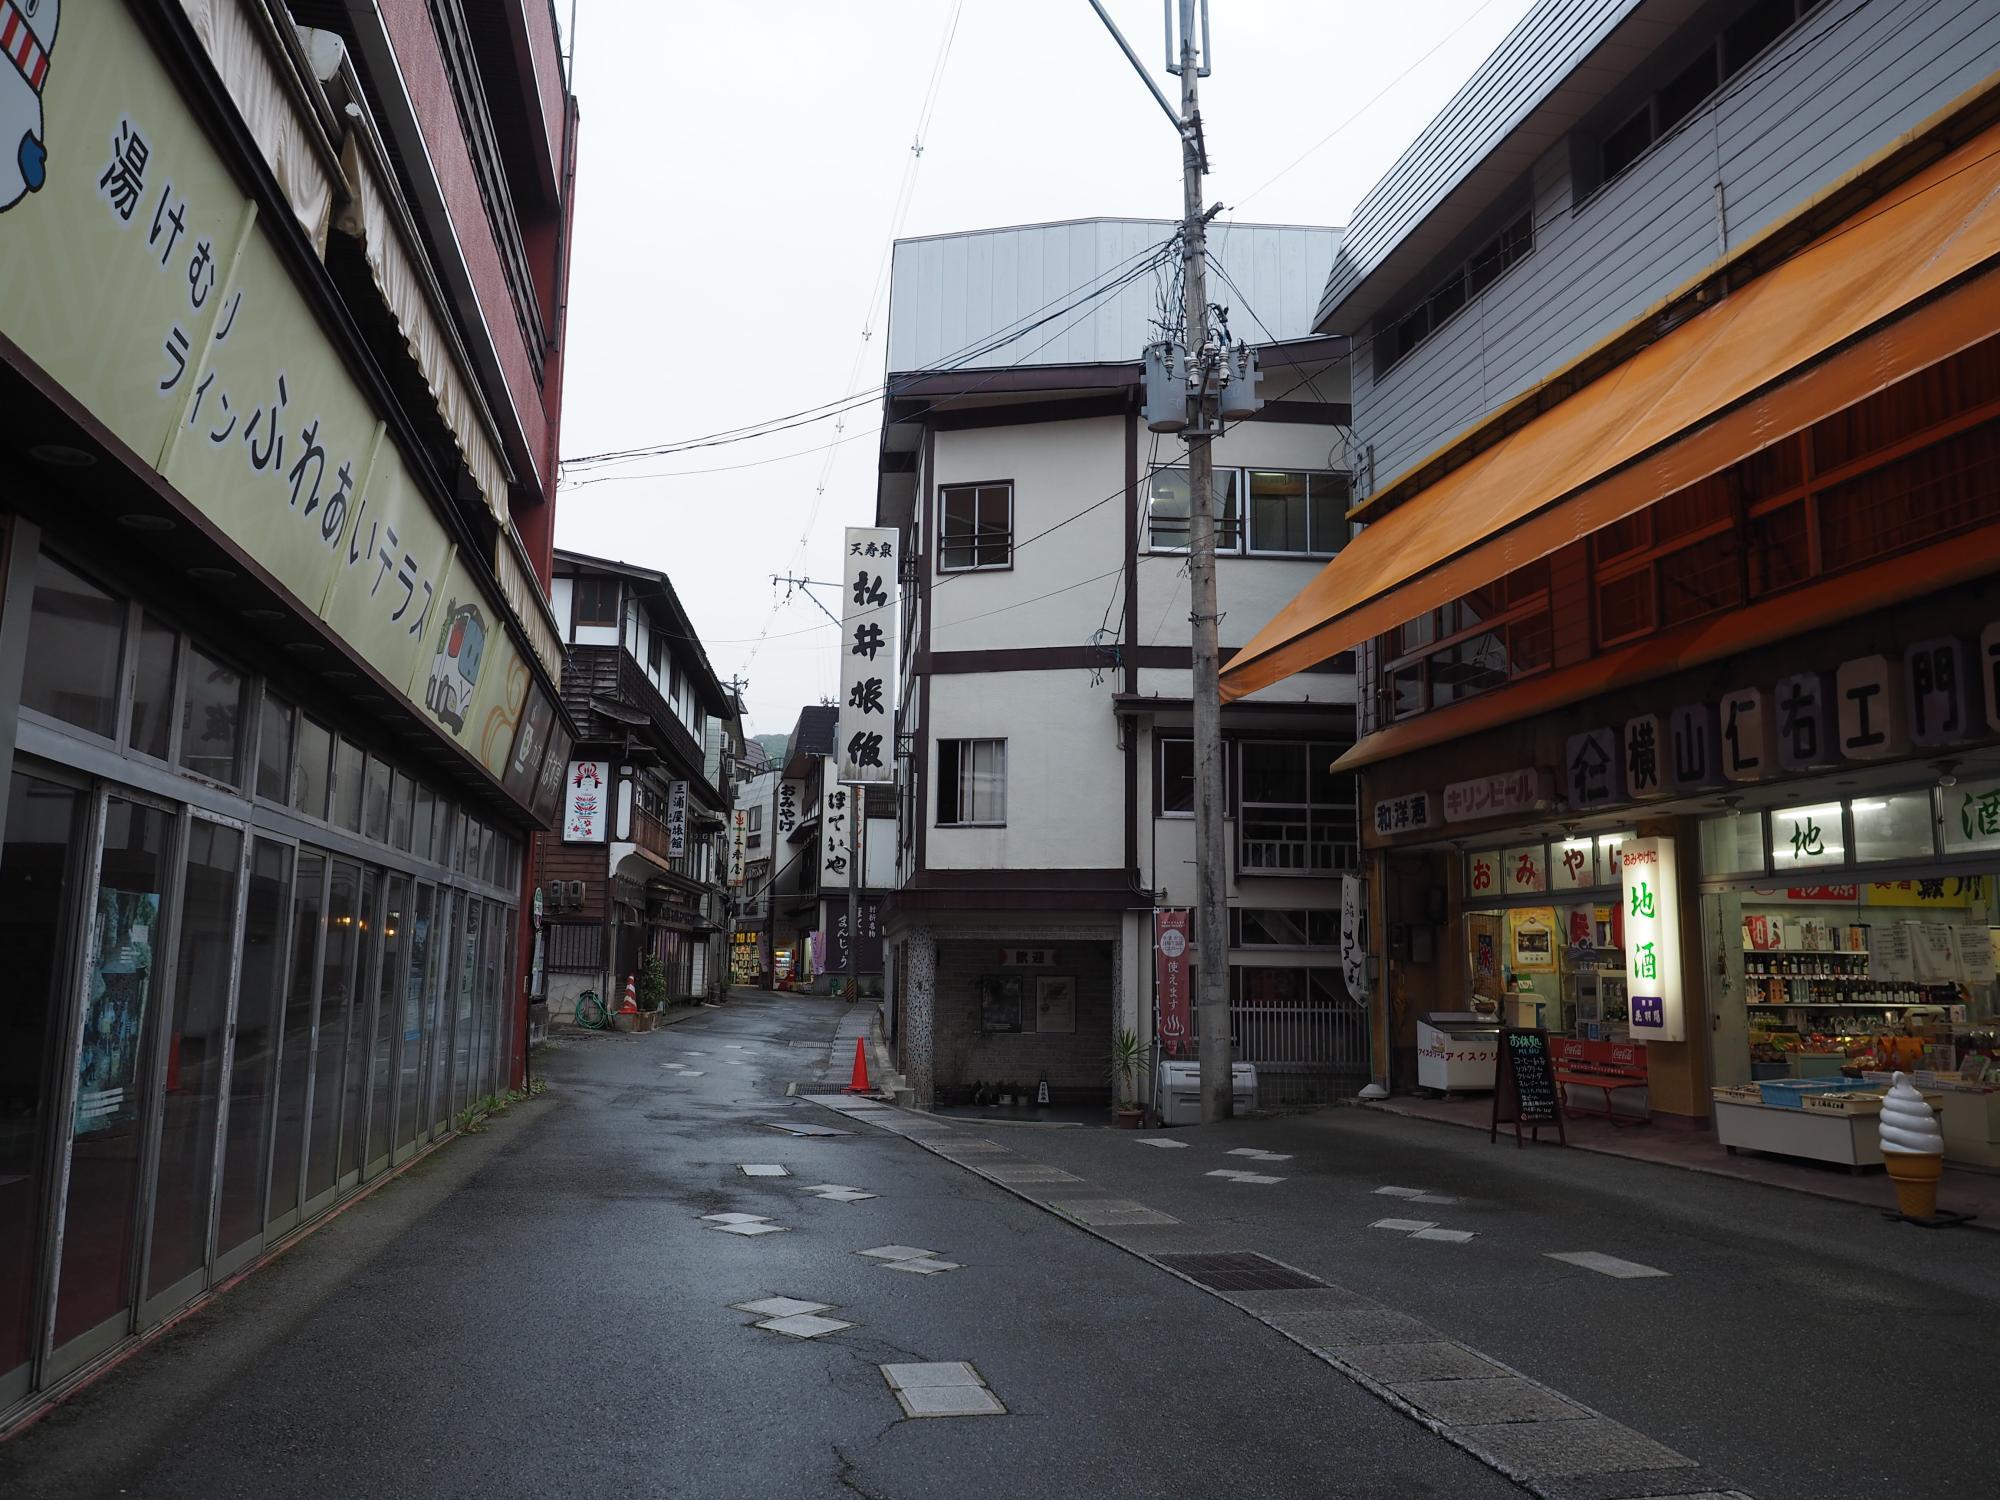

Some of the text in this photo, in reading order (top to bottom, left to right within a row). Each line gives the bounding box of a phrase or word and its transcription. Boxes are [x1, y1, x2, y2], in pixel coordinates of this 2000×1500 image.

[100, 119, 242, 340] 湯けむり
[160, 328, 237, 443] ライン
[244, 374, 434, 643] ふれあいテラス
[850, 542, 892, 558] 天寿泉
[1628, 644, 2000, 790] 横山仁右エ門
[672, 784, 685, 848] 三浦屋旅館
[1377, 796, 1427, 831] 和洋酒
[1447, 775, 1534, 815] キリンビール
[1790, 817, 1825, 860] 地
[1631, 882, 1656, 980] 地酒
[1167, 962, 1179, 1010] 使えます
